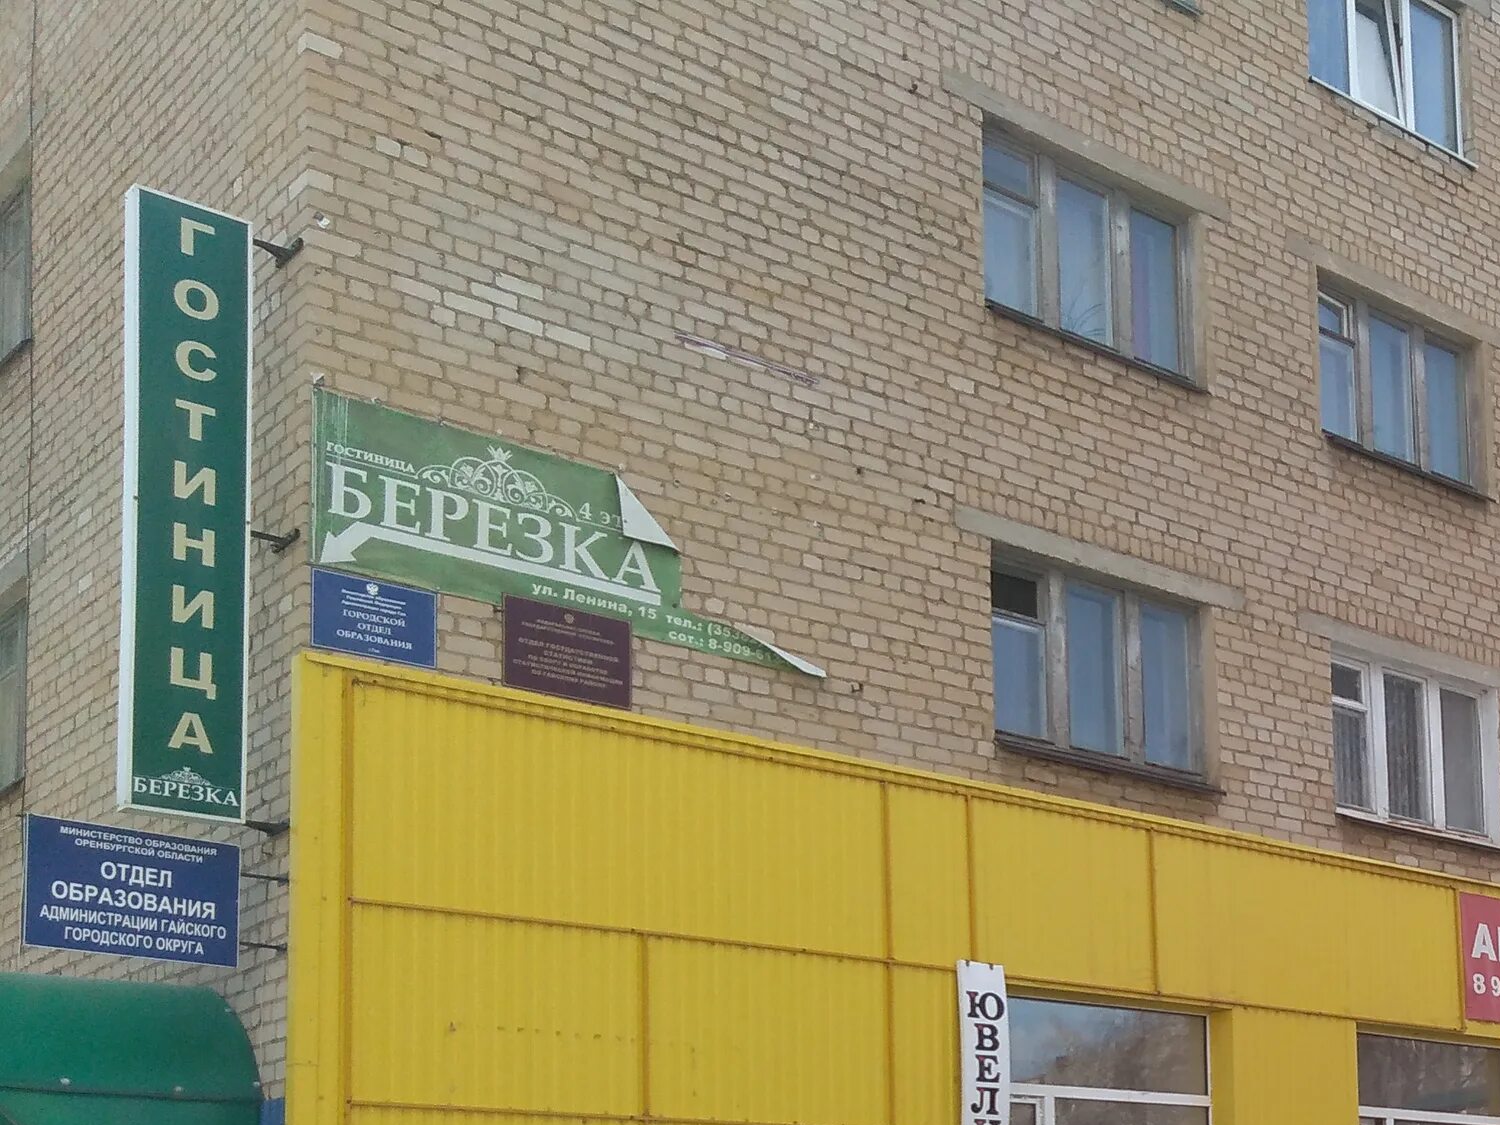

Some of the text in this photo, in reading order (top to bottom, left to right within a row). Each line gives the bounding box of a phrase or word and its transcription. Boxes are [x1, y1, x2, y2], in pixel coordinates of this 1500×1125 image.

[326, 441, 415, 473] ГОСТИНИЦА
[168, 217, 217, 755] ГОСТИНИЦА
[326, 461, 661, 592] БЕРЕЗКА
[578, 502, 592, 521] 4
[532, 582, 557, 597] ул.
[563, 588, 633, 617] Ленина,
[638, 604, 657, 620] 15
[342, 608, 406, 627] ГОРОДСКОЙ
[357, 622, 392, 636] ОТДЕЛ
[336, 628, 413, 650] ОБРАЗОВАНИЯ
[133, 776, 239, 807] БЕРЕЗКА
[60, 825, 218, 857] МИНИСТЕРСТВО ОБРАЗОВАНИЯ
[74, 837, 204, 864] ОРЕНБУРГСКОЙ ОБЛАСТИ
[101, 861, 173, 889] ОТДЕЛ
[51, 880, 217, 920] ОБРАЗОВАНИЯ
[39, 904, 227, 940] АДМИНИСТРАЦИИ ГАЙСКОГО
[64, 926, 204, 956] ГОРОДСКОГО ОКРУГА
[1472, 973, 1487, 995] 8
